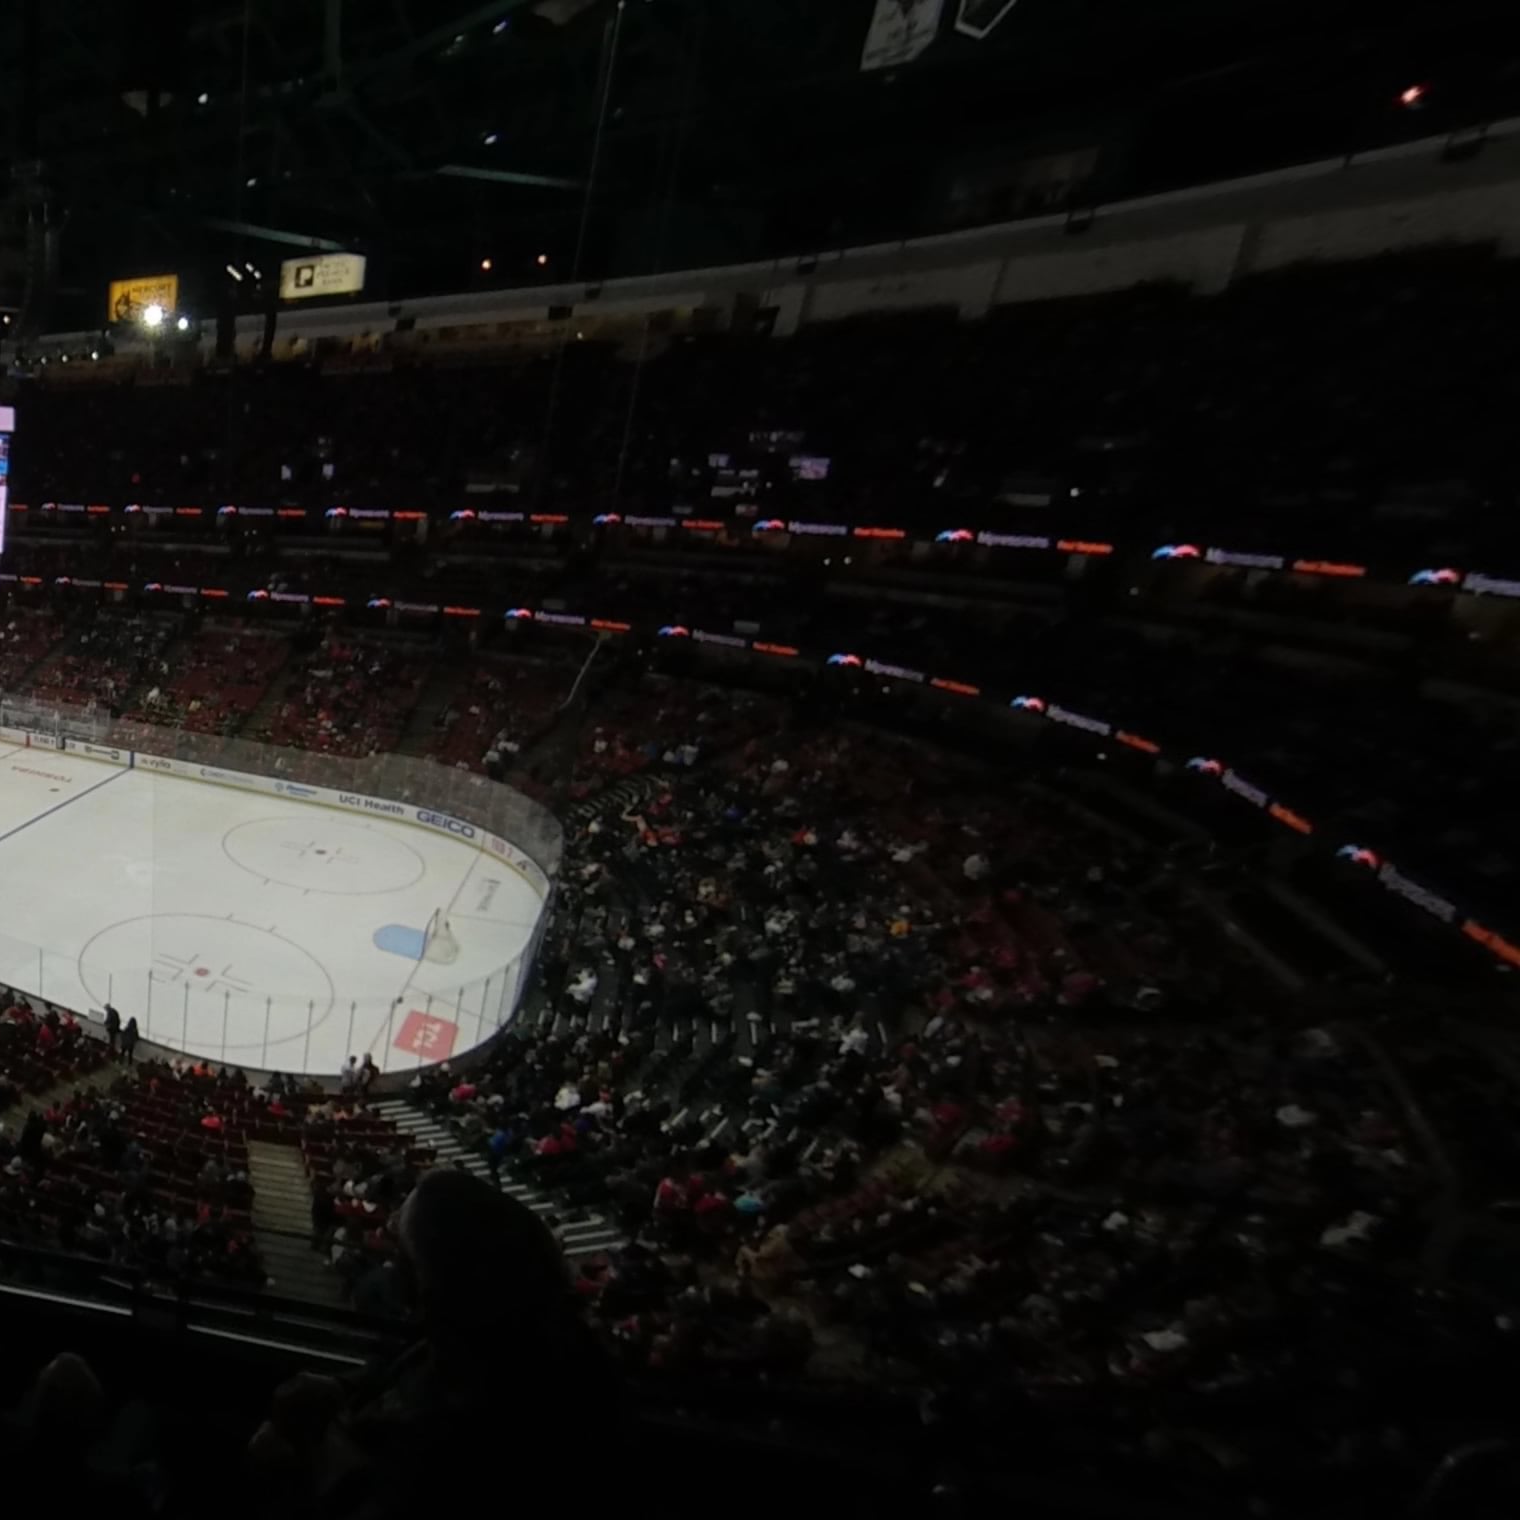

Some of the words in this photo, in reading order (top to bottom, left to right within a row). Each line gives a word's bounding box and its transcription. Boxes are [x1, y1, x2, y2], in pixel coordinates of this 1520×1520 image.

[339, 793, 361, 806] UCI
[364, 799, 405, 816] Health
[416, 810, 476, 839] GEICO
